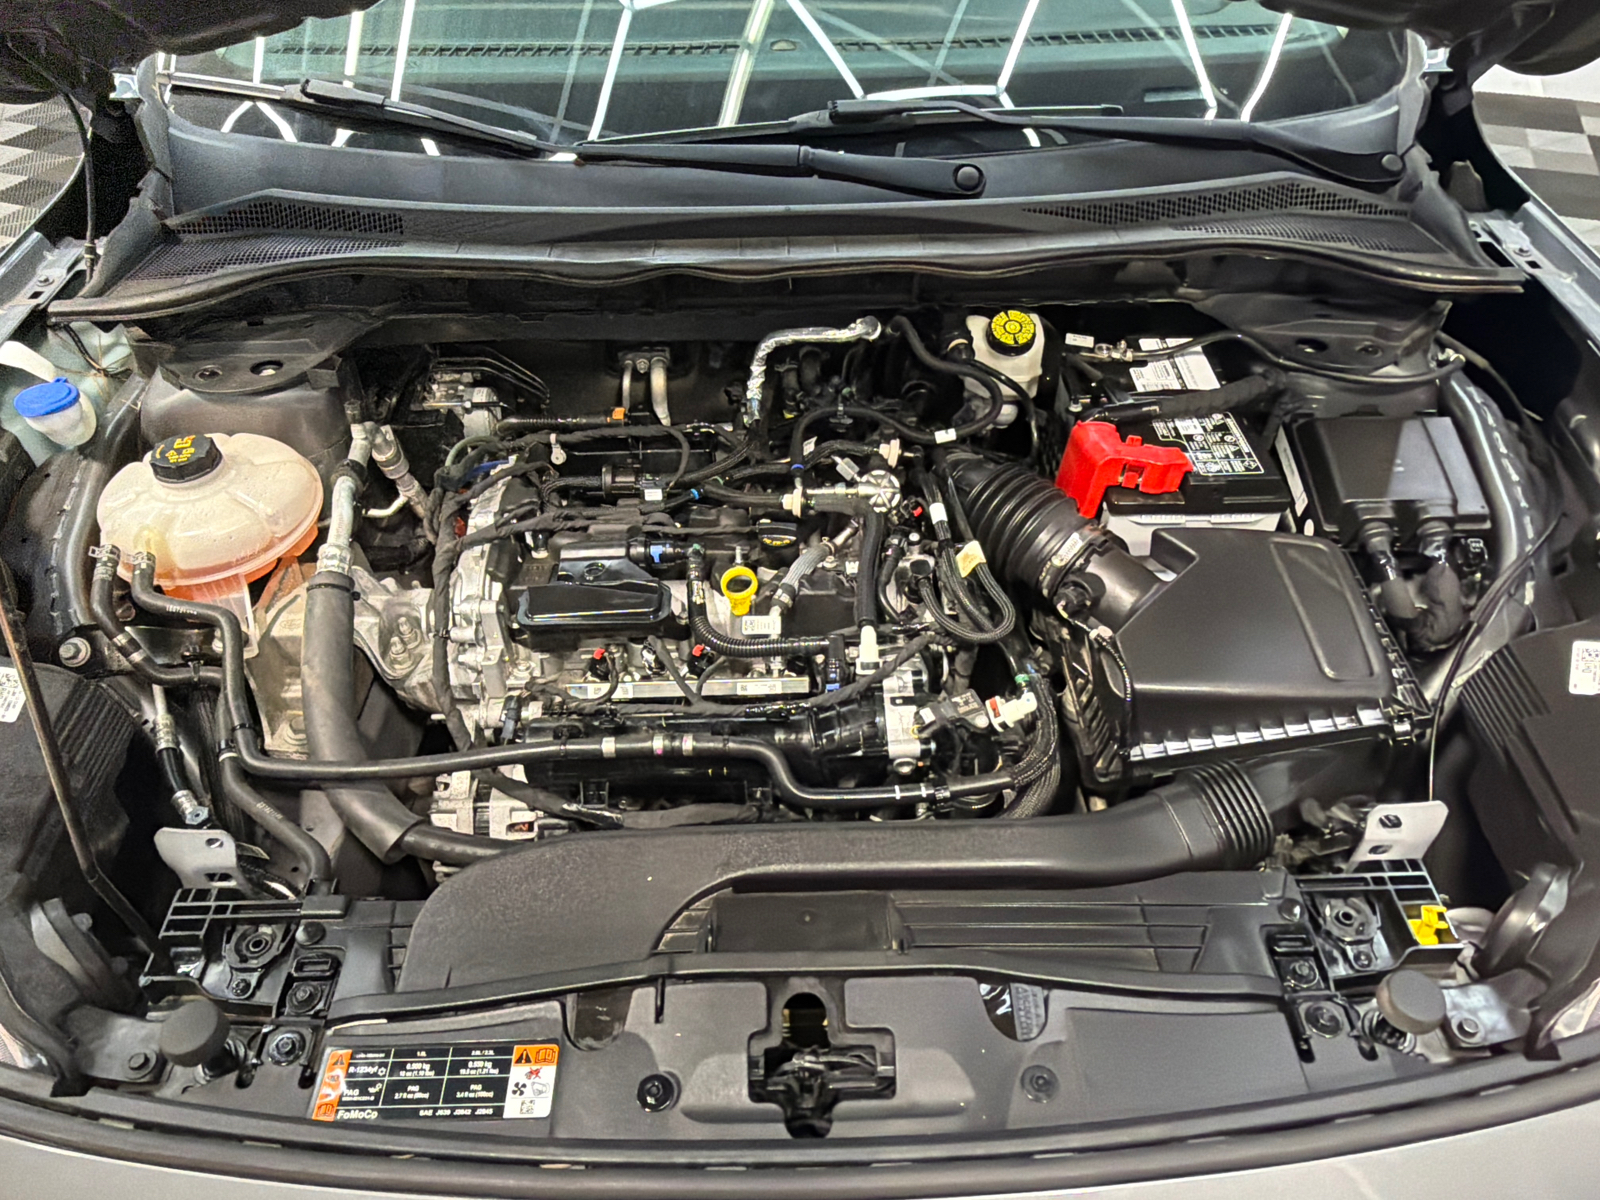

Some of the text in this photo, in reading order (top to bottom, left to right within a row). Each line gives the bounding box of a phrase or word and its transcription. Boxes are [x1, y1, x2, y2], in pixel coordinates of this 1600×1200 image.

[422, 1063, 431, 1071] kg
[484, 1061, 493, 1069] kg
[348, 1066, 378, 1074] R-1234yf
[337, 1110, 378, 1120] FoMoCo
[419, 1109, 433, 1117] SAE
